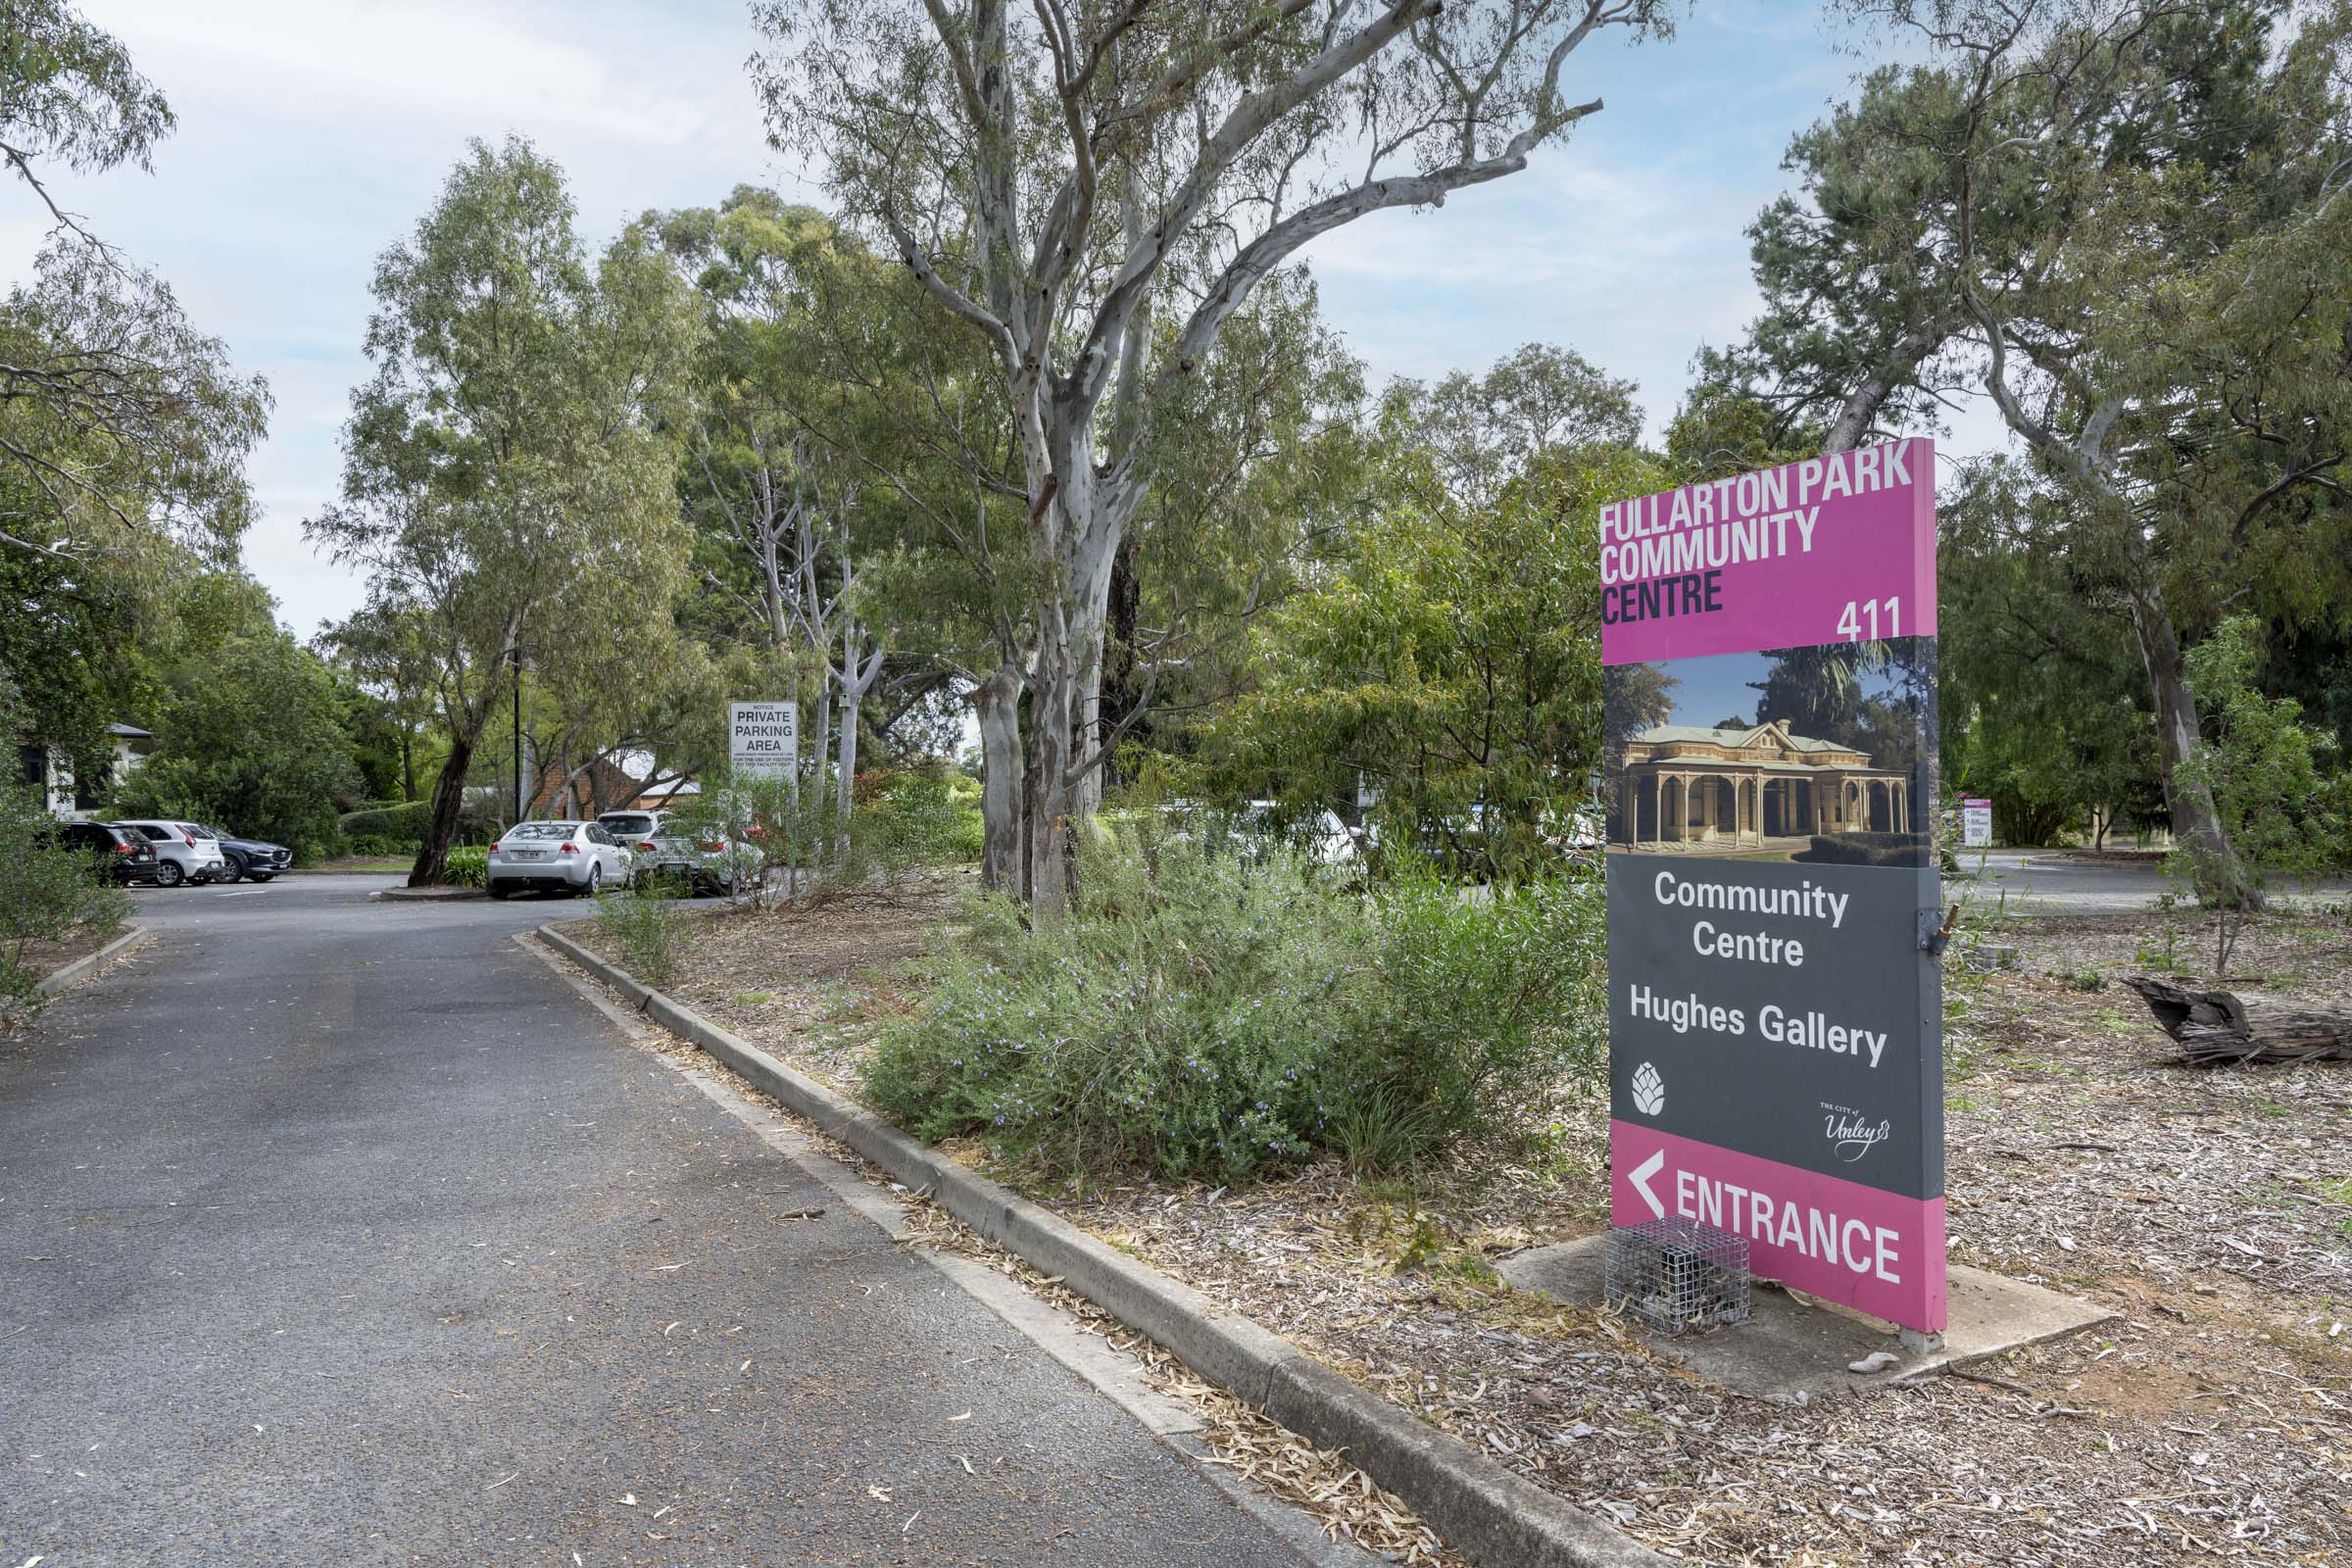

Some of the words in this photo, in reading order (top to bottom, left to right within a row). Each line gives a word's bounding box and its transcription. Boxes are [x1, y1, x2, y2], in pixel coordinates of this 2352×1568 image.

[1600, 465, 1788, 545] FULLARTON
[1798, 439, 1913, 506] PARK
[1600, 506, 1820, 585] COMMUNITY
[1601, 569, 1723, 625] CENTRE
[1837, 596, 1899, 642] 411
[735, 725, 792, 737] PARKING
[737, 711, 790, 722] PRIVATE
[746, 740, 781, 751] AREA
[1654, 871, 1849, 928] Community
[1693, 921, 1804, 966] Centre
[1631, 984, 1745, 1035] Hughes
[1759, 1004, 1887, 1068] Gallery
[1820, 1102, 1834, 1110] THE
[1835, 1105, 1850, 1114] CITY
[1825, 1114, 1877, 1161] Unley
[1677, 1169, 1900, 1284] ENTRANCE
